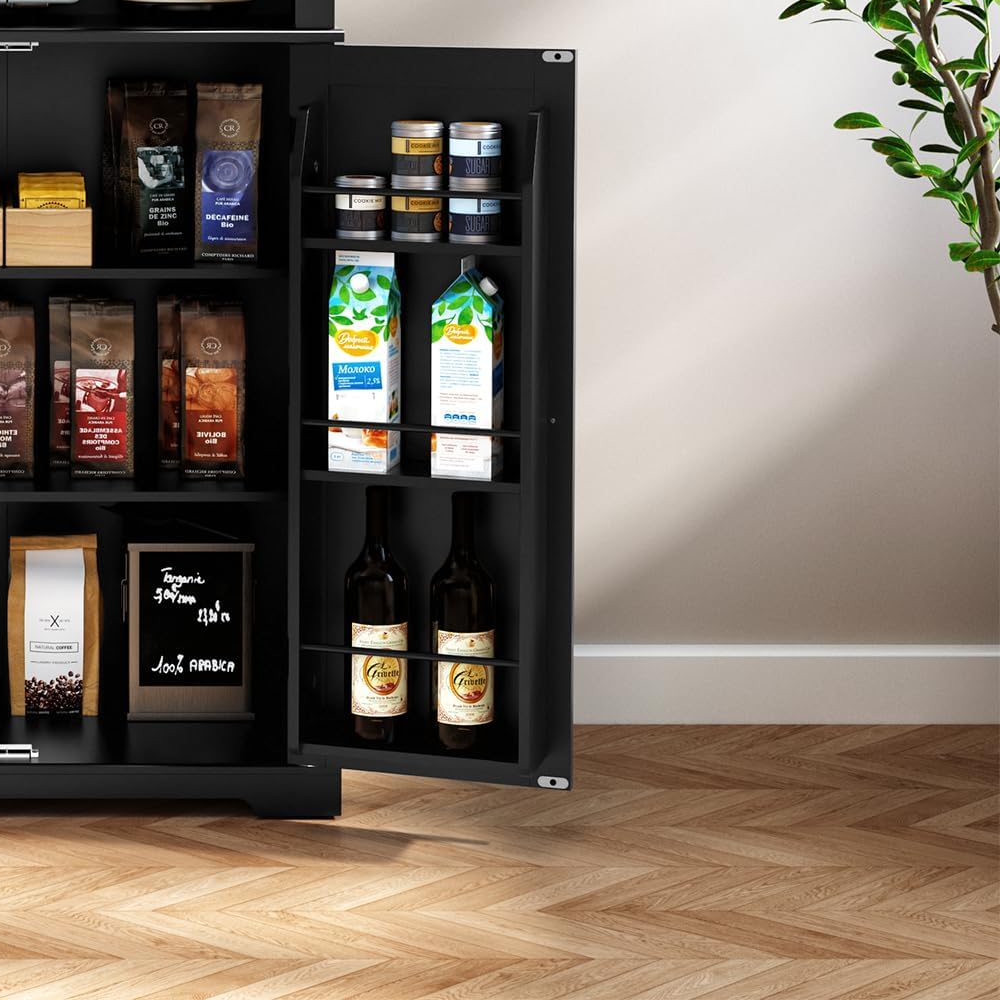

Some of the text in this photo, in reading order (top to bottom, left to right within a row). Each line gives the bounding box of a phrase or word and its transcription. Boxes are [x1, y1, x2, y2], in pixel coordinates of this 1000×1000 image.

[338, 364, 376, 374] Молоко
[50, 615, 60, 628] X
[152, 654, 235, 676] 100% ARABICA
